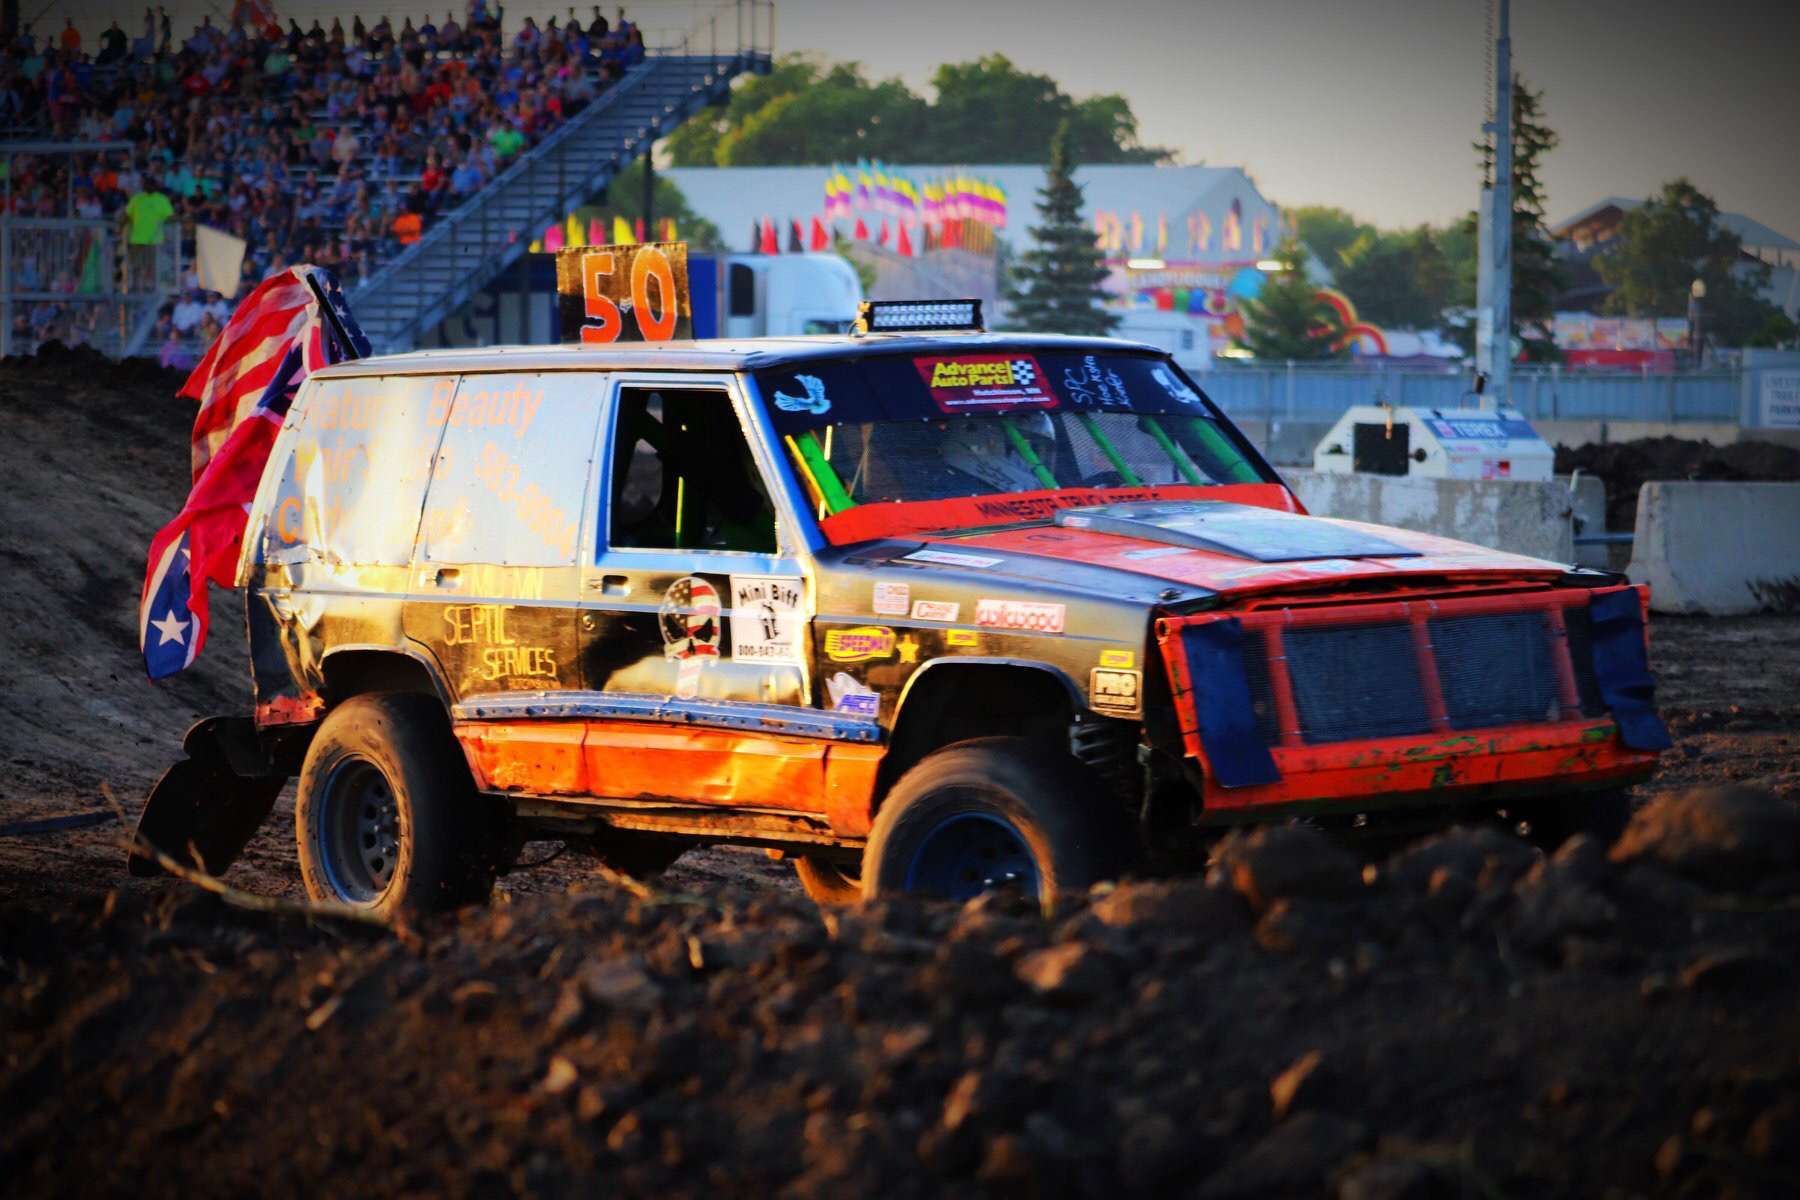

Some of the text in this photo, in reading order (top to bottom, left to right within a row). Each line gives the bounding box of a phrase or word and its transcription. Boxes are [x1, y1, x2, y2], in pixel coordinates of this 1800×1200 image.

[931, 374, 1008, 387] Auto Parts
[934, 361, 1006, 376] Advance
[427, 380, 543, 440] Beauty
[973, 497, 1056, 520] MINNESOTA
[738, 582, 798, 607] Mini Biff
[443, 605, 516, 646] SEPTIC
[481, 647, 558, 681] SERVICES
